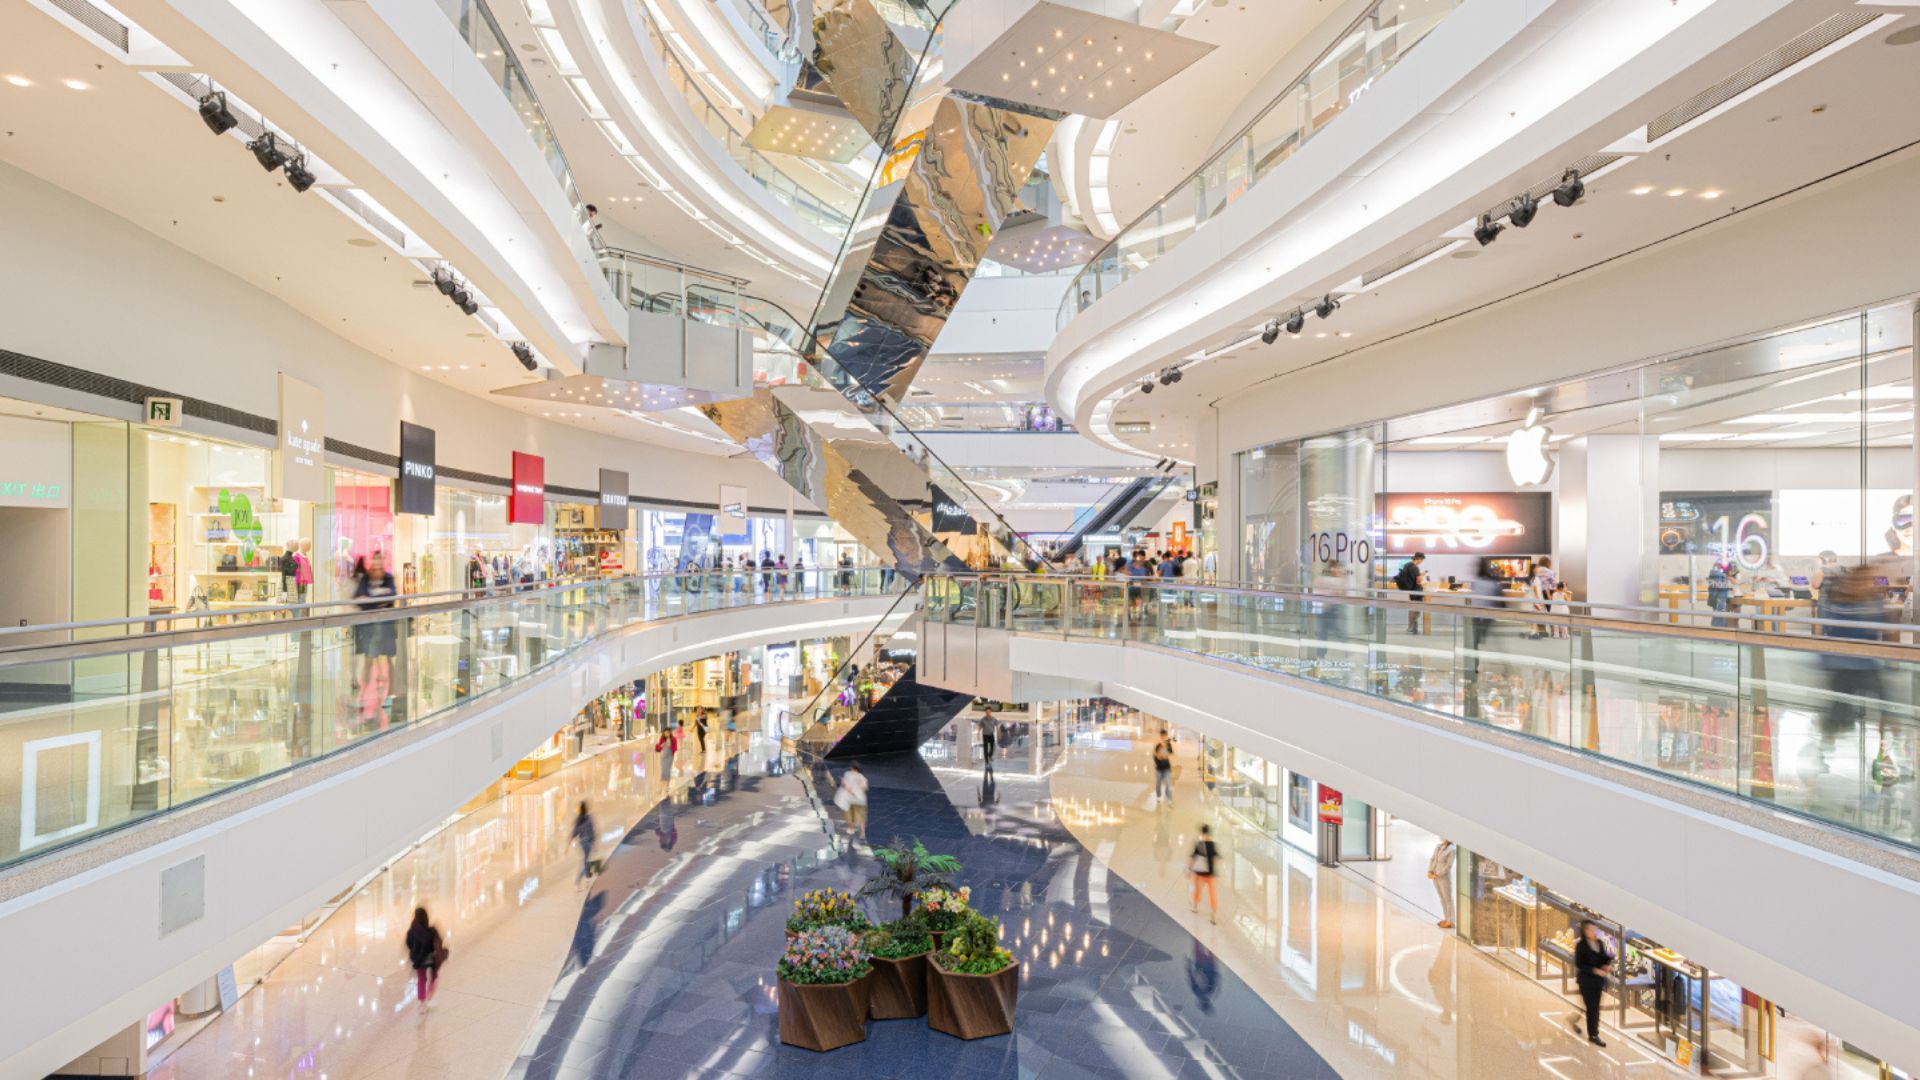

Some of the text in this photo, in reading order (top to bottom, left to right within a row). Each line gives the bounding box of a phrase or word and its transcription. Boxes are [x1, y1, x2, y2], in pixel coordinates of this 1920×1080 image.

[405, 460, 433, 479] PINKO
[233, 508, 249, 527] JOY
[1392, 505, 1496, 548] PRO
[1309, 532, 1369, 564] 16 Pro
[1710, 513, 1767, 570] 16
